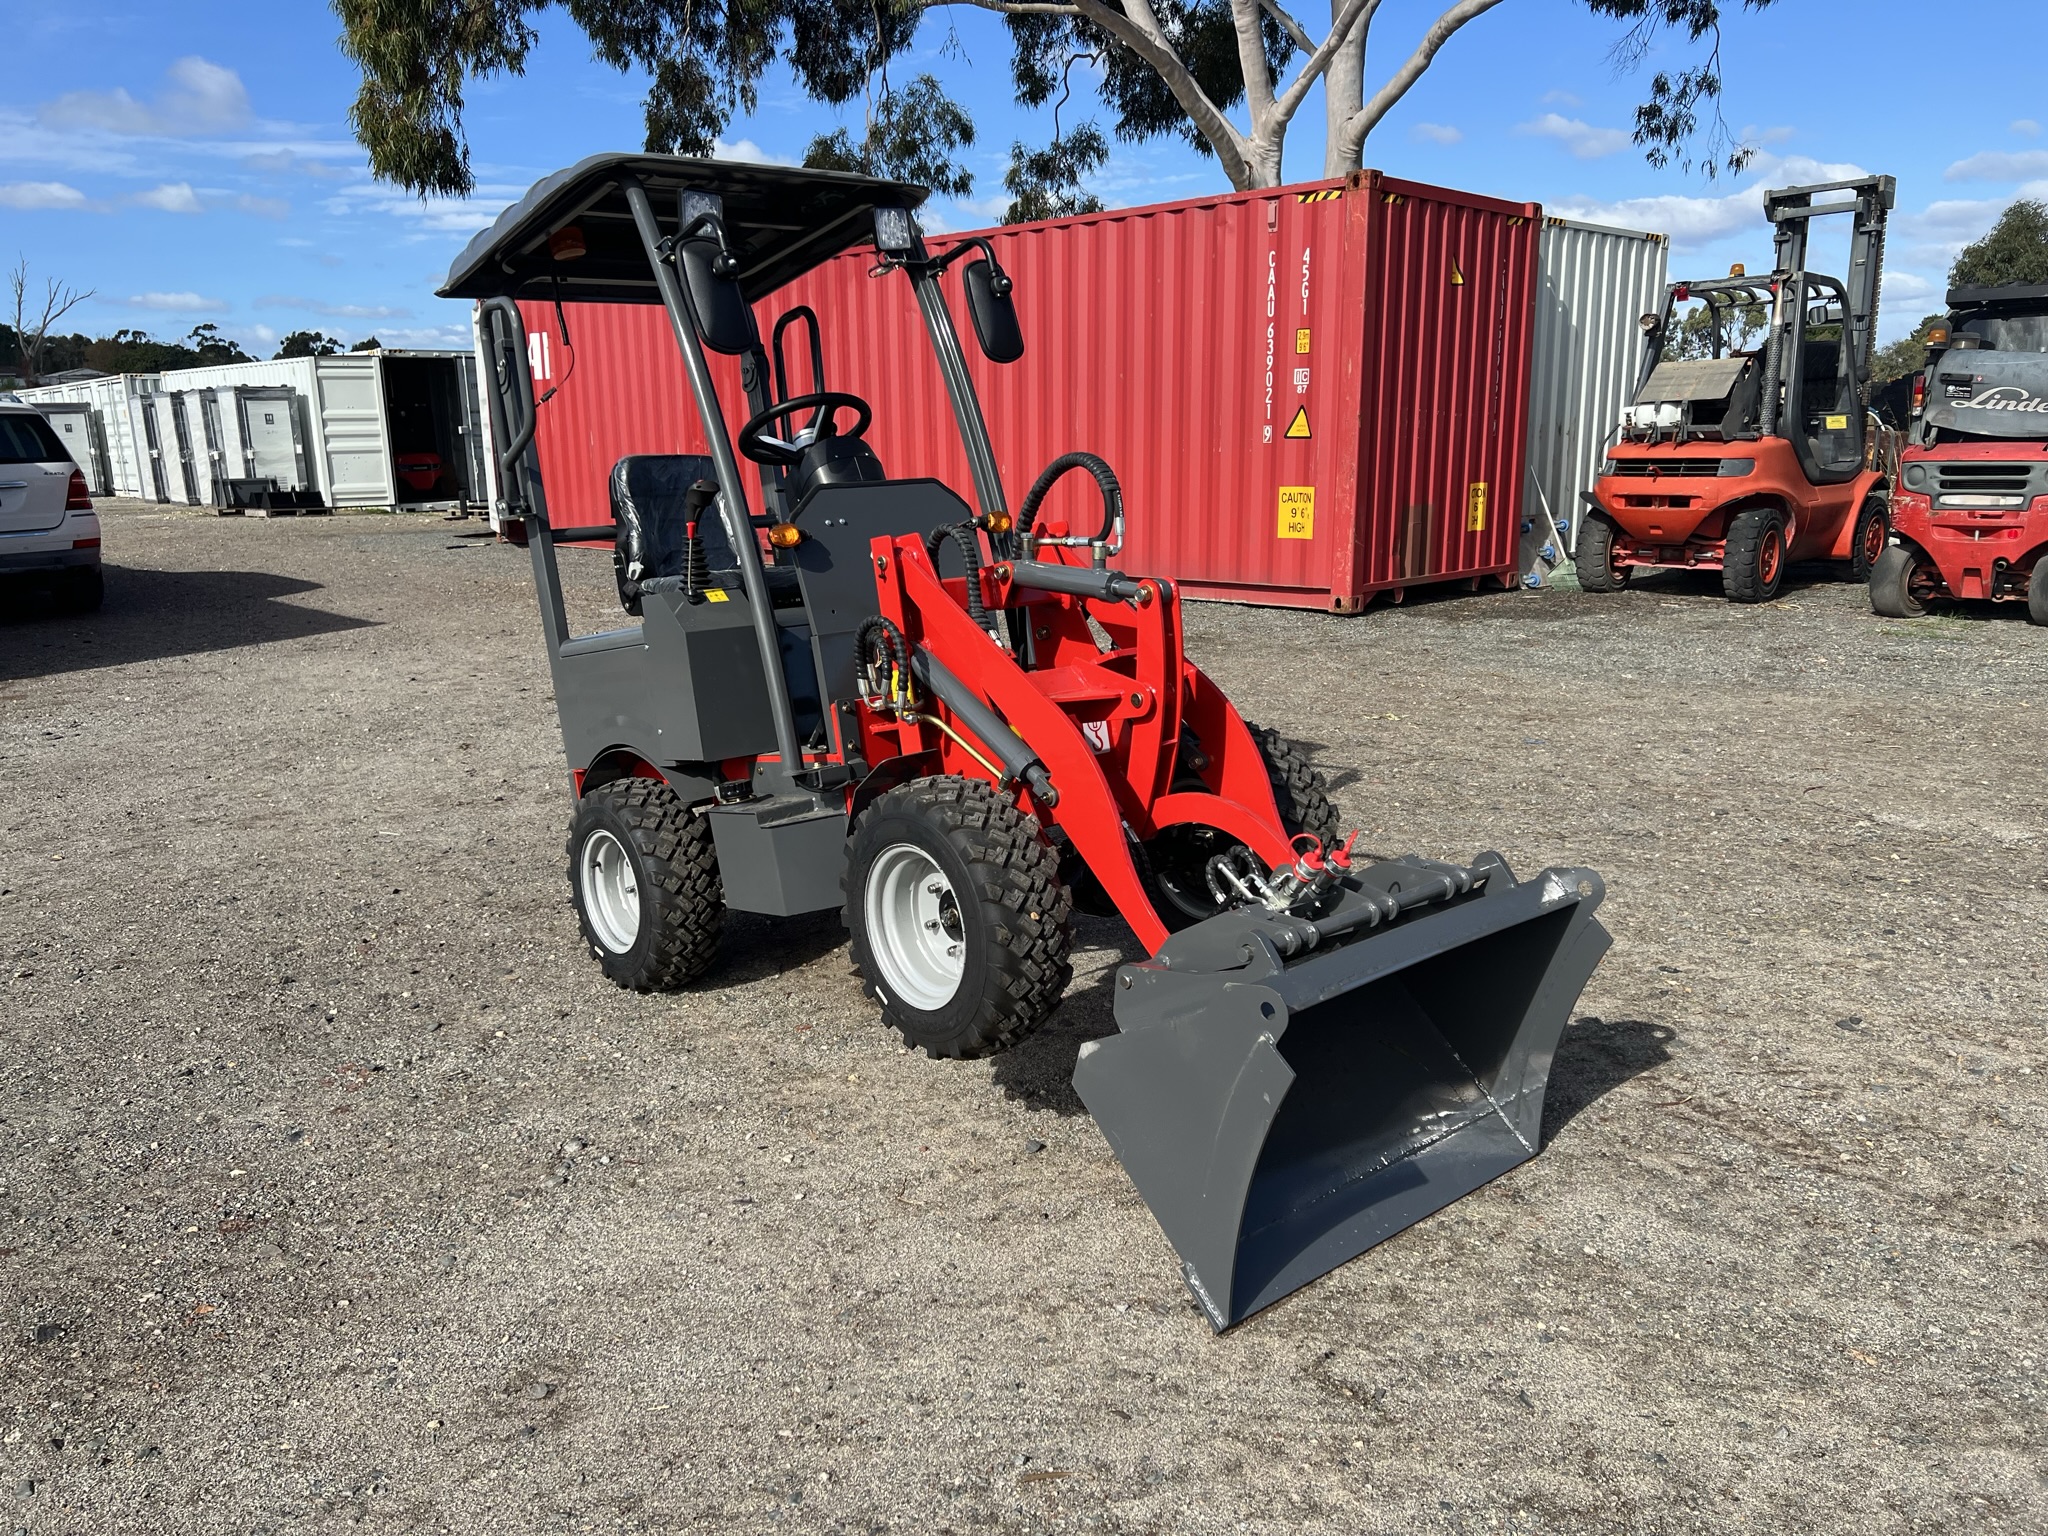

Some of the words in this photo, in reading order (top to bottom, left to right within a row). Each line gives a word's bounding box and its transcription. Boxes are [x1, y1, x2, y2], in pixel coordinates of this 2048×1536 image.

[1267, 250, 1276, 318] CAAU
[1302, 247, 1310, 316] 45G1
[1265, 322, 1275, 420] 639021
[1296, 385, 1307, 394] 87
[1950, 386, 2048, 413] Linde
[1263, 426, 1272, 442] 9
